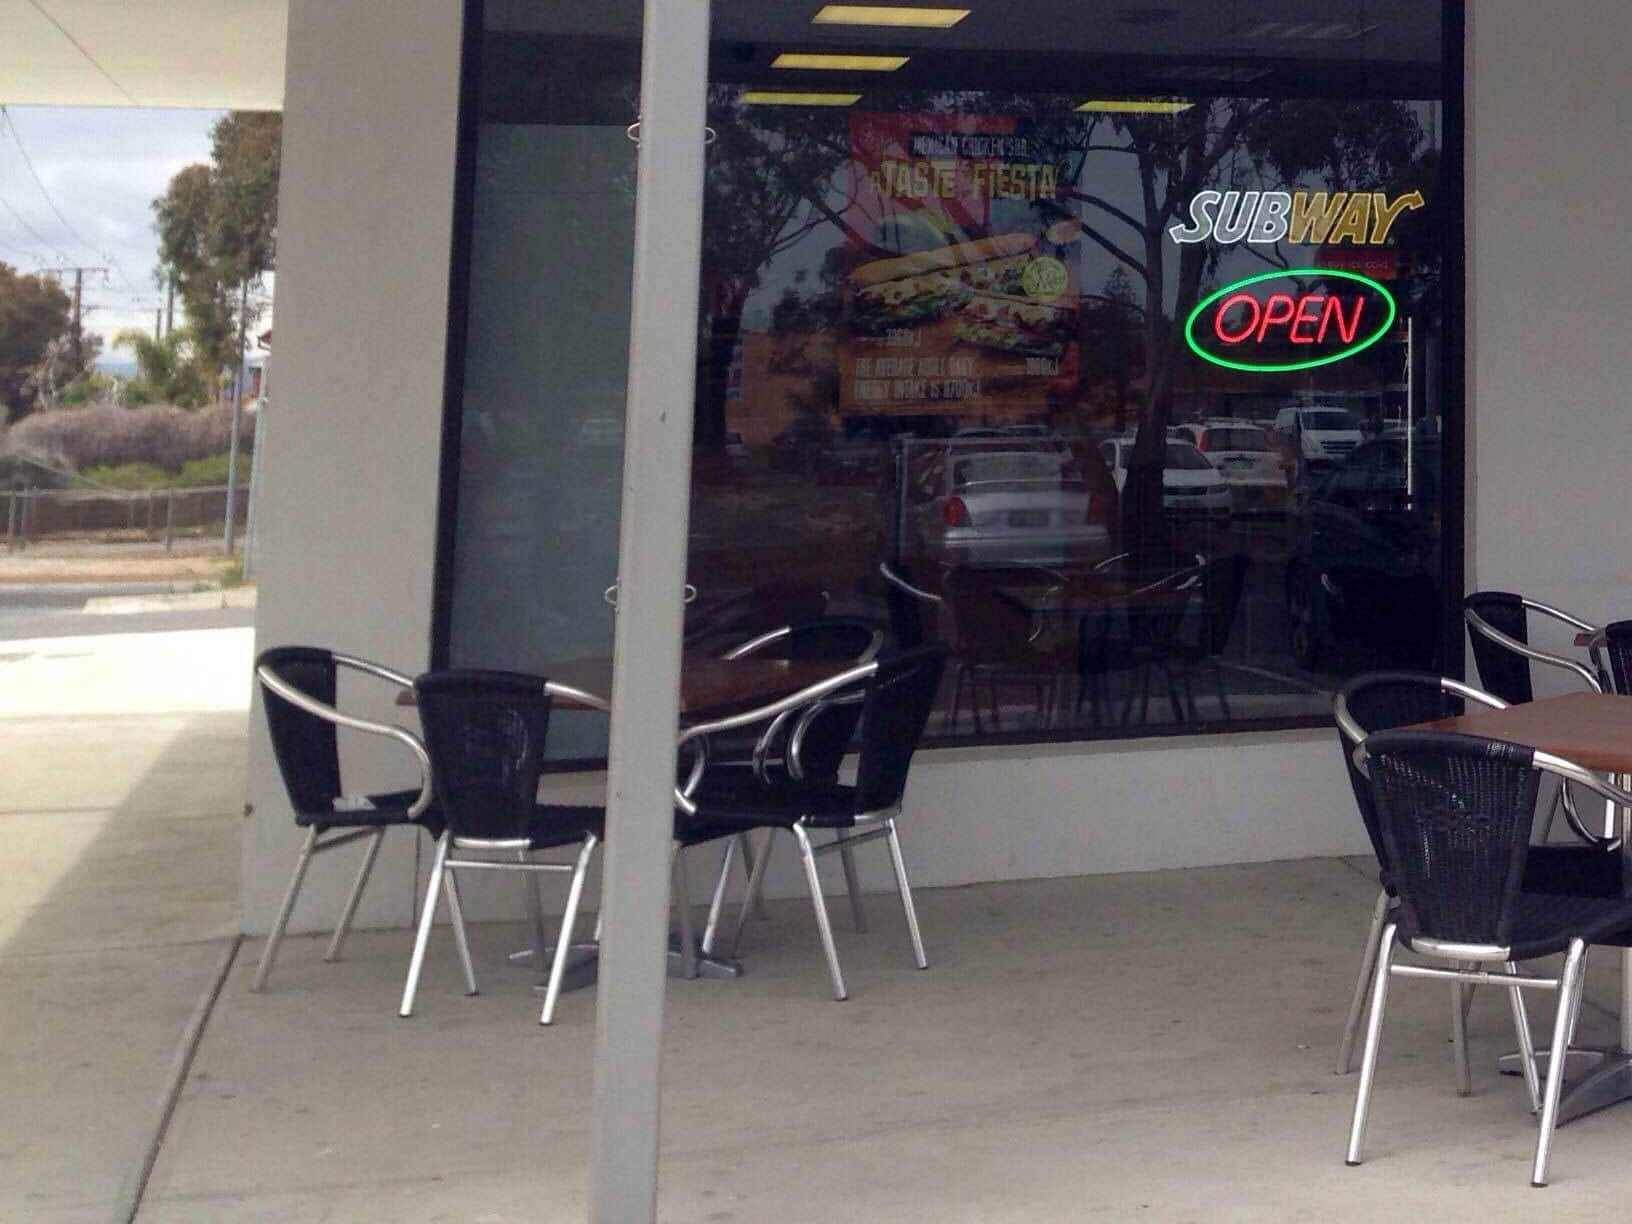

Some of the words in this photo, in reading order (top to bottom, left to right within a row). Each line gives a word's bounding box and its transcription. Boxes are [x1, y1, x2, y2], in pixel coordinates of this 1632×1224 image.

[881, 160, 955, 199] TASTE
[1169, 190, 1425, 244] SUBWAY
[1214, 294, 1365, 344] OPEN
